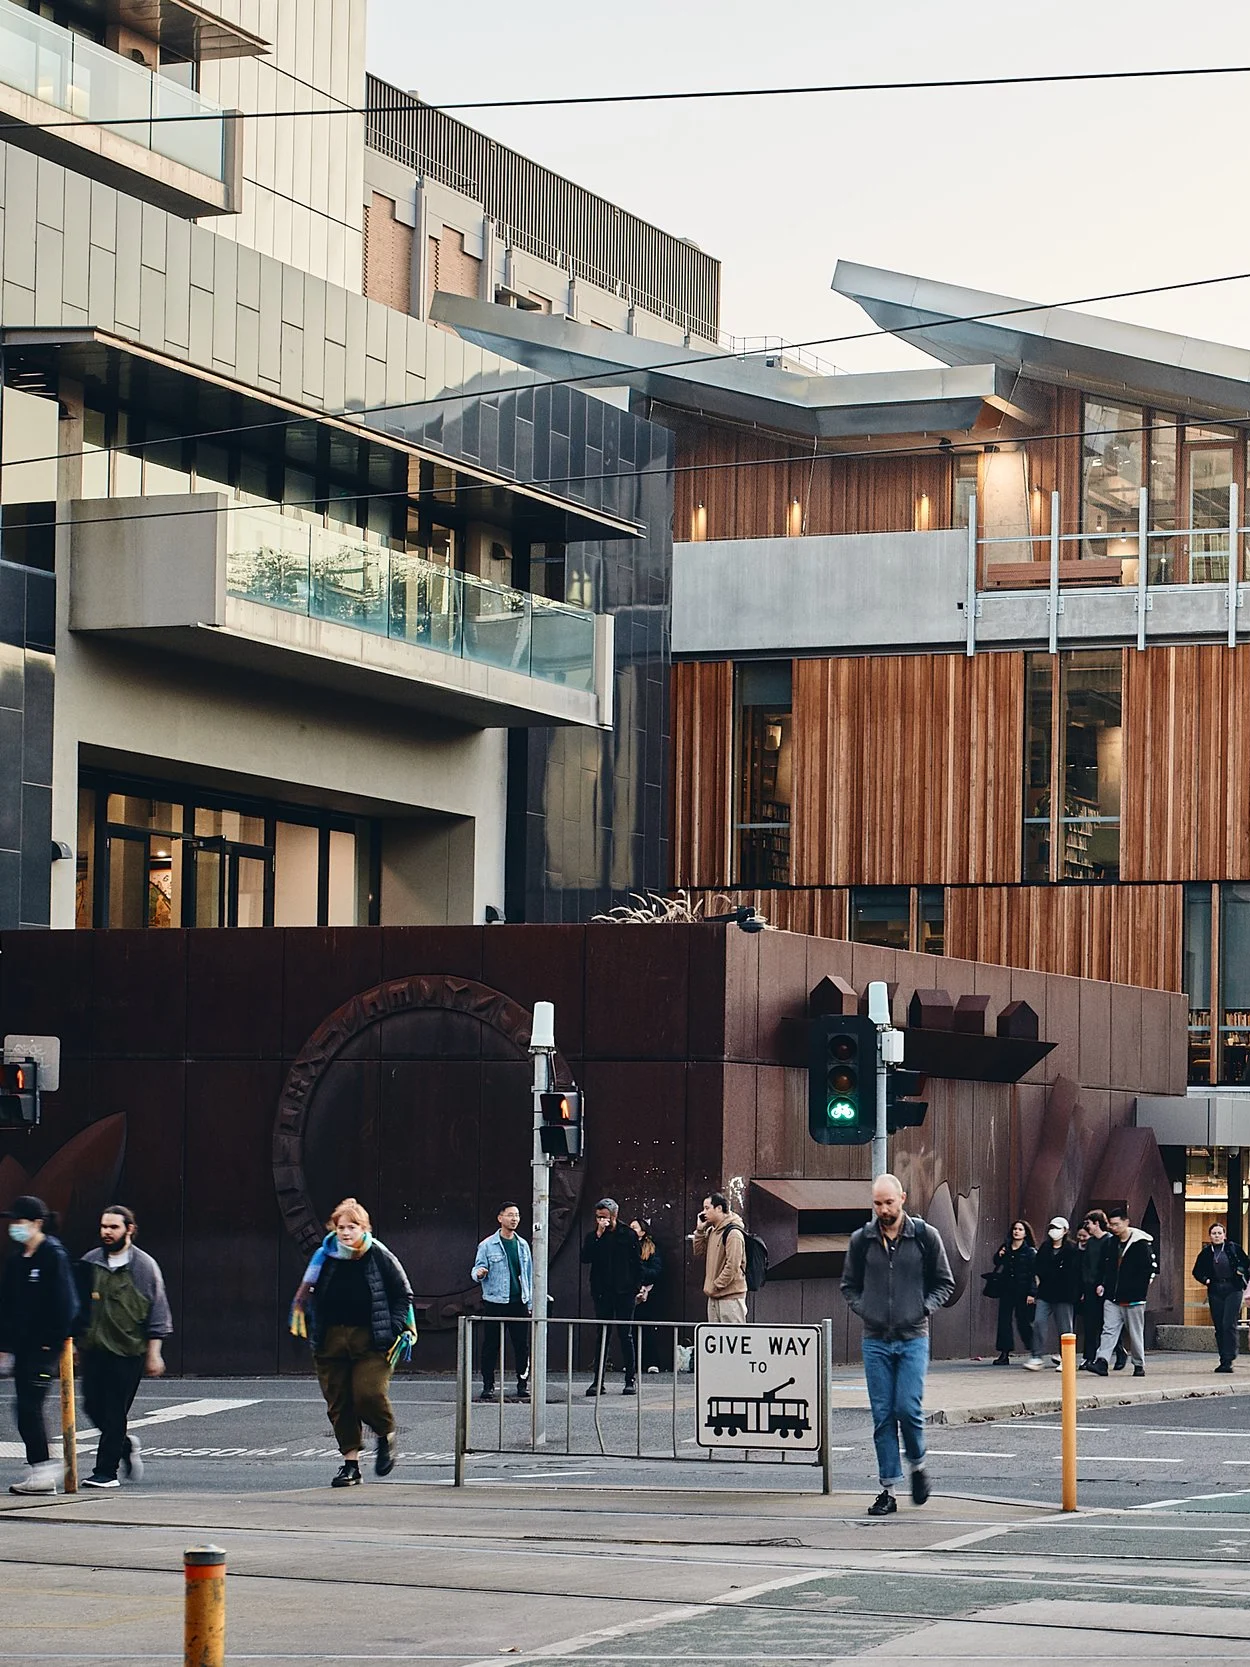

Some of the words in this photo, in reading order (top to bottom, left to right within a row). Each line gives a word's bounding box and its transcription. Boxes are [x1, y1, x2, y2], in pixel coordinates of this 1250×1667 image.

[704, 1335, 752, 1355] GIVE
[768, 1336, 811, 1356] WAY
[749, 1361, 768, 1374] TO
